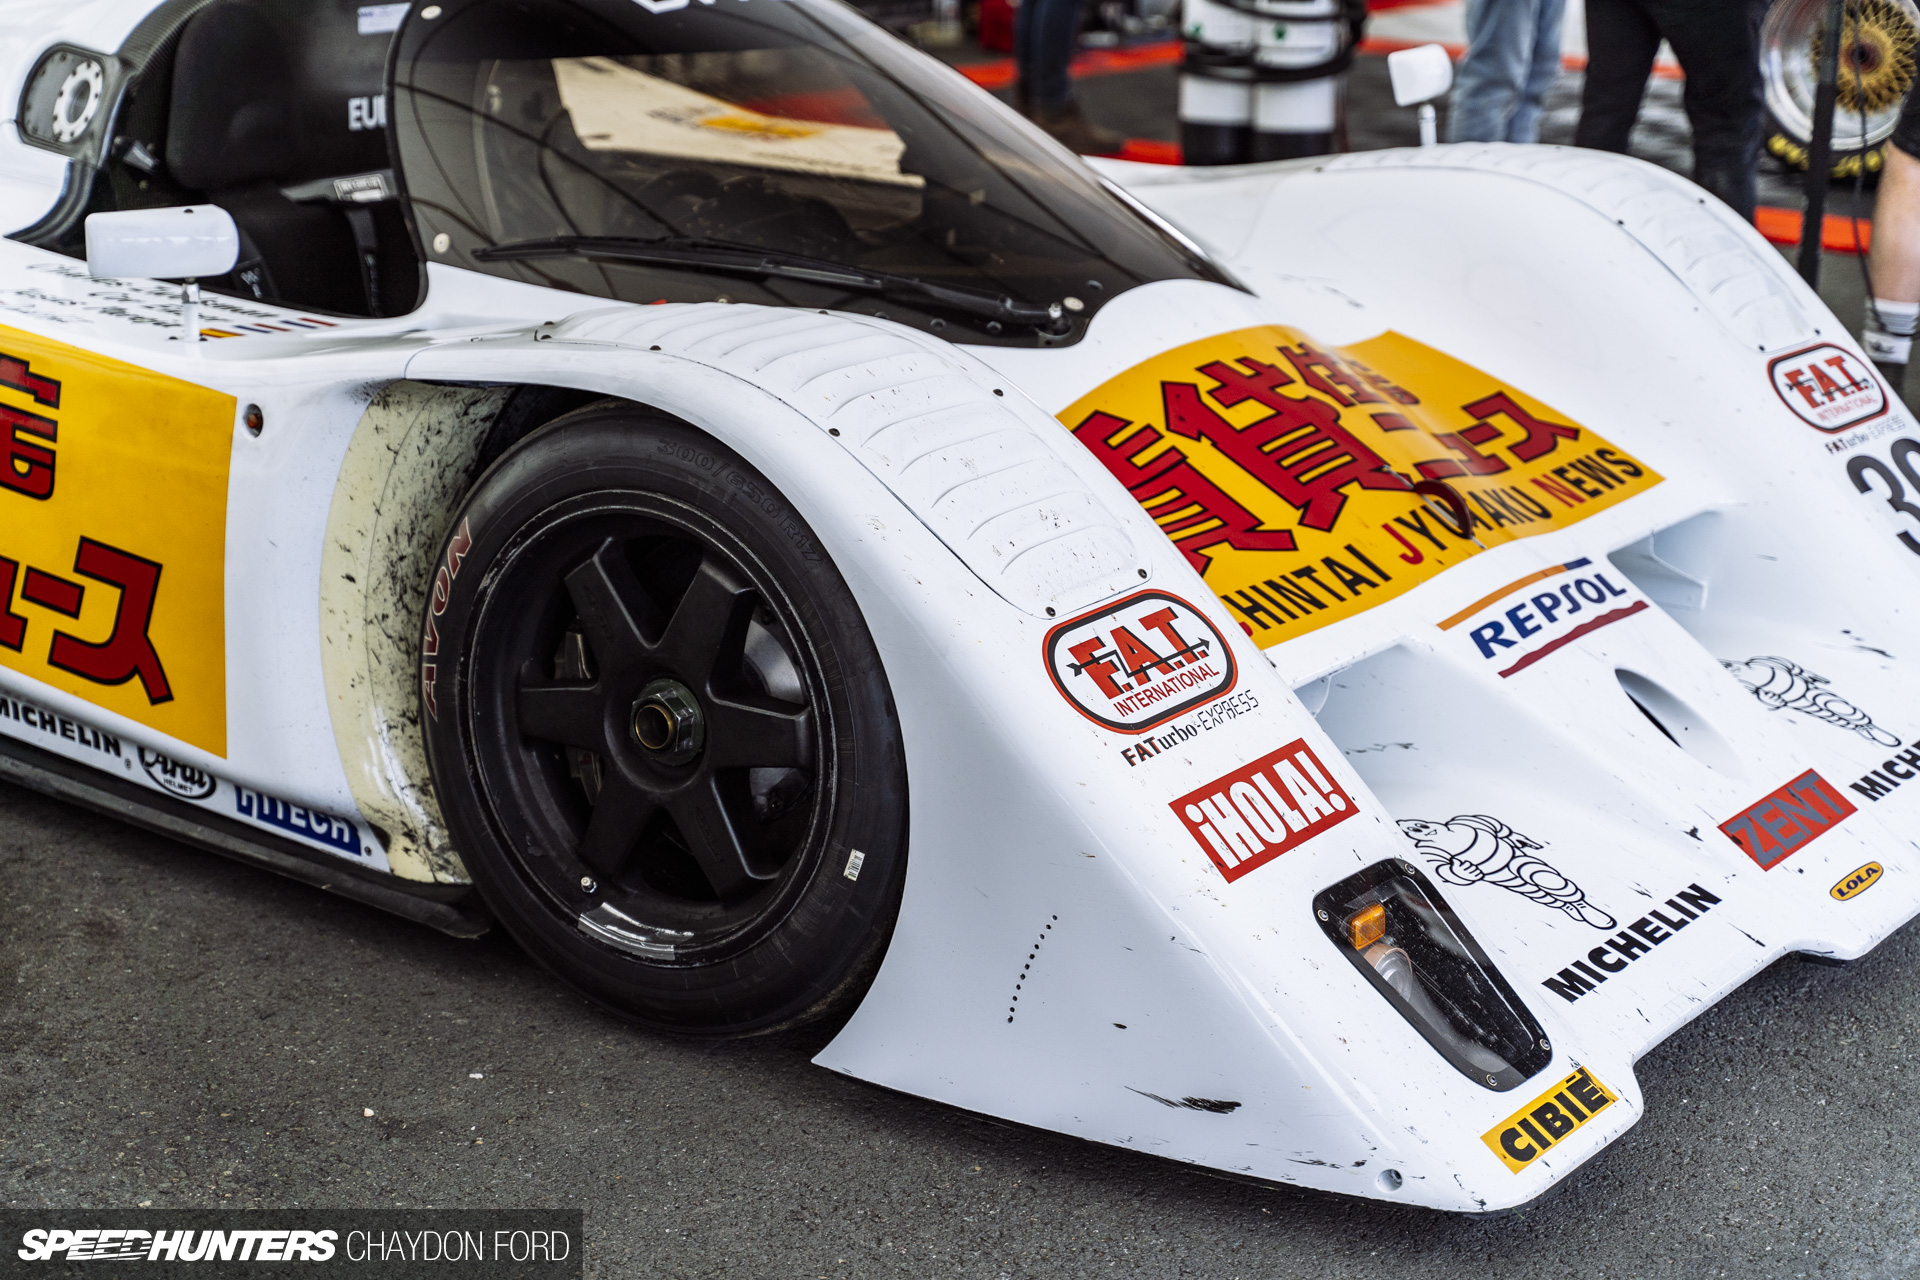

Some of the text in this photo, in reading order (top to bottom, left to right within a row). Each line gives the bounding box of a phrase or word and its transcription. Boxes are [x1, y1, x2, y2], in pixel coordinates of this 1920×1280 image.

[1220, 447, 1644, 637] HINTAI JYUAKU NEWS
[422, 516, 472, 722] AVON
[1469, 573, 1627, 660] REPSOL
[1113, 663, 1220, 717] INTERNATIONAL
[1120, 689, 1259, 767] FATurbo-EXPRESS
[163, 777, 193, 793] HELMET
[1185, 750, 1346, 870] ¡HOLA!
[1724, 771, 1844, 866] ZENT
[1836, 866, 1880, 898] LOLA
[1541, 883, 1722, 1004] MICHELIN
